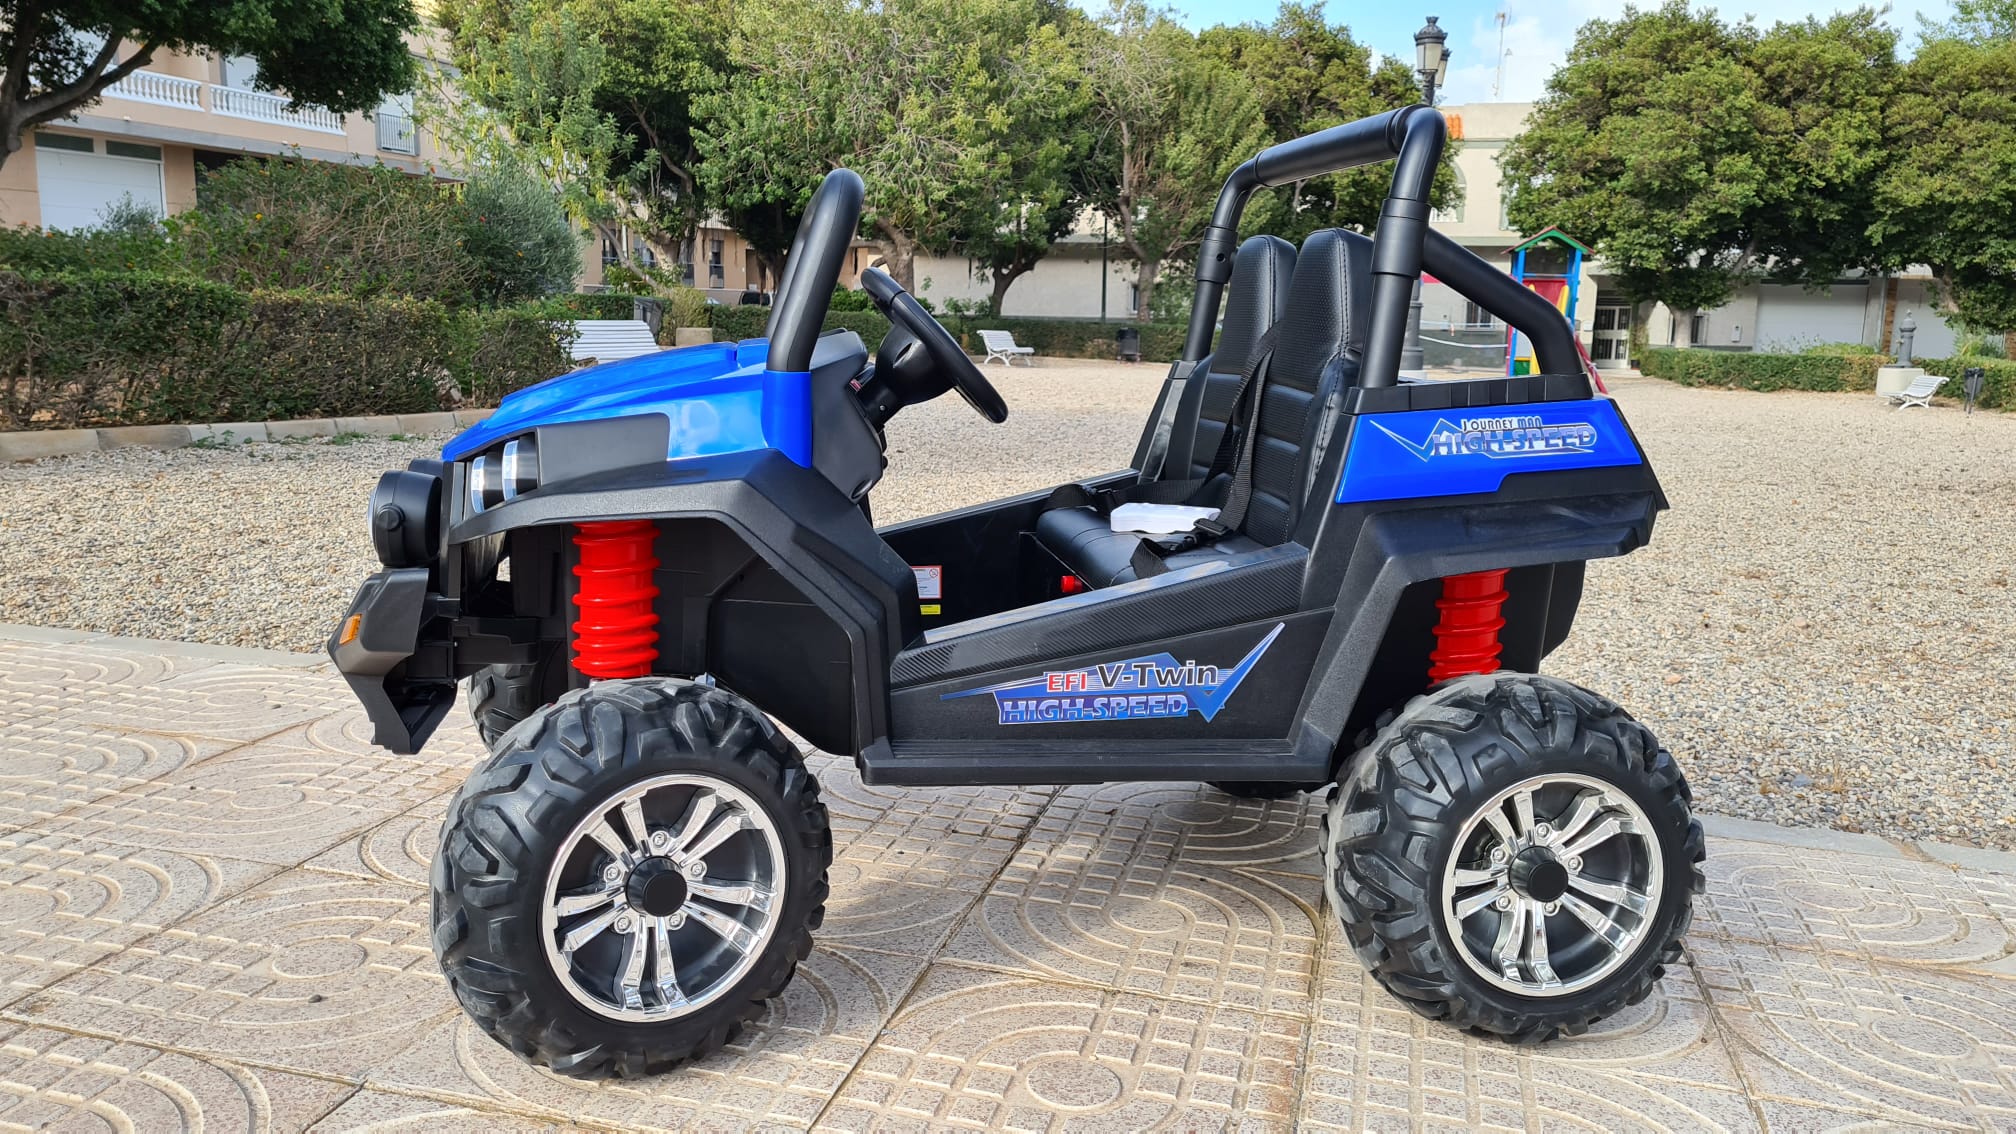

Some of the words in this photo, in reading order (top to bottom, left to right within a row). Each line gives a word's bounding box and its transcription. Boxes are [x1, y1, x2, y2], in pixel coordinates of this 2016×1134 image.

[1516, 416, 1543, 429] MAN
[1047, 672, 1088, 692] EFI
[1096, 660, 1218, 689] V-Twin
[1003, 694, 1188, 722] HIGH-SPEED
